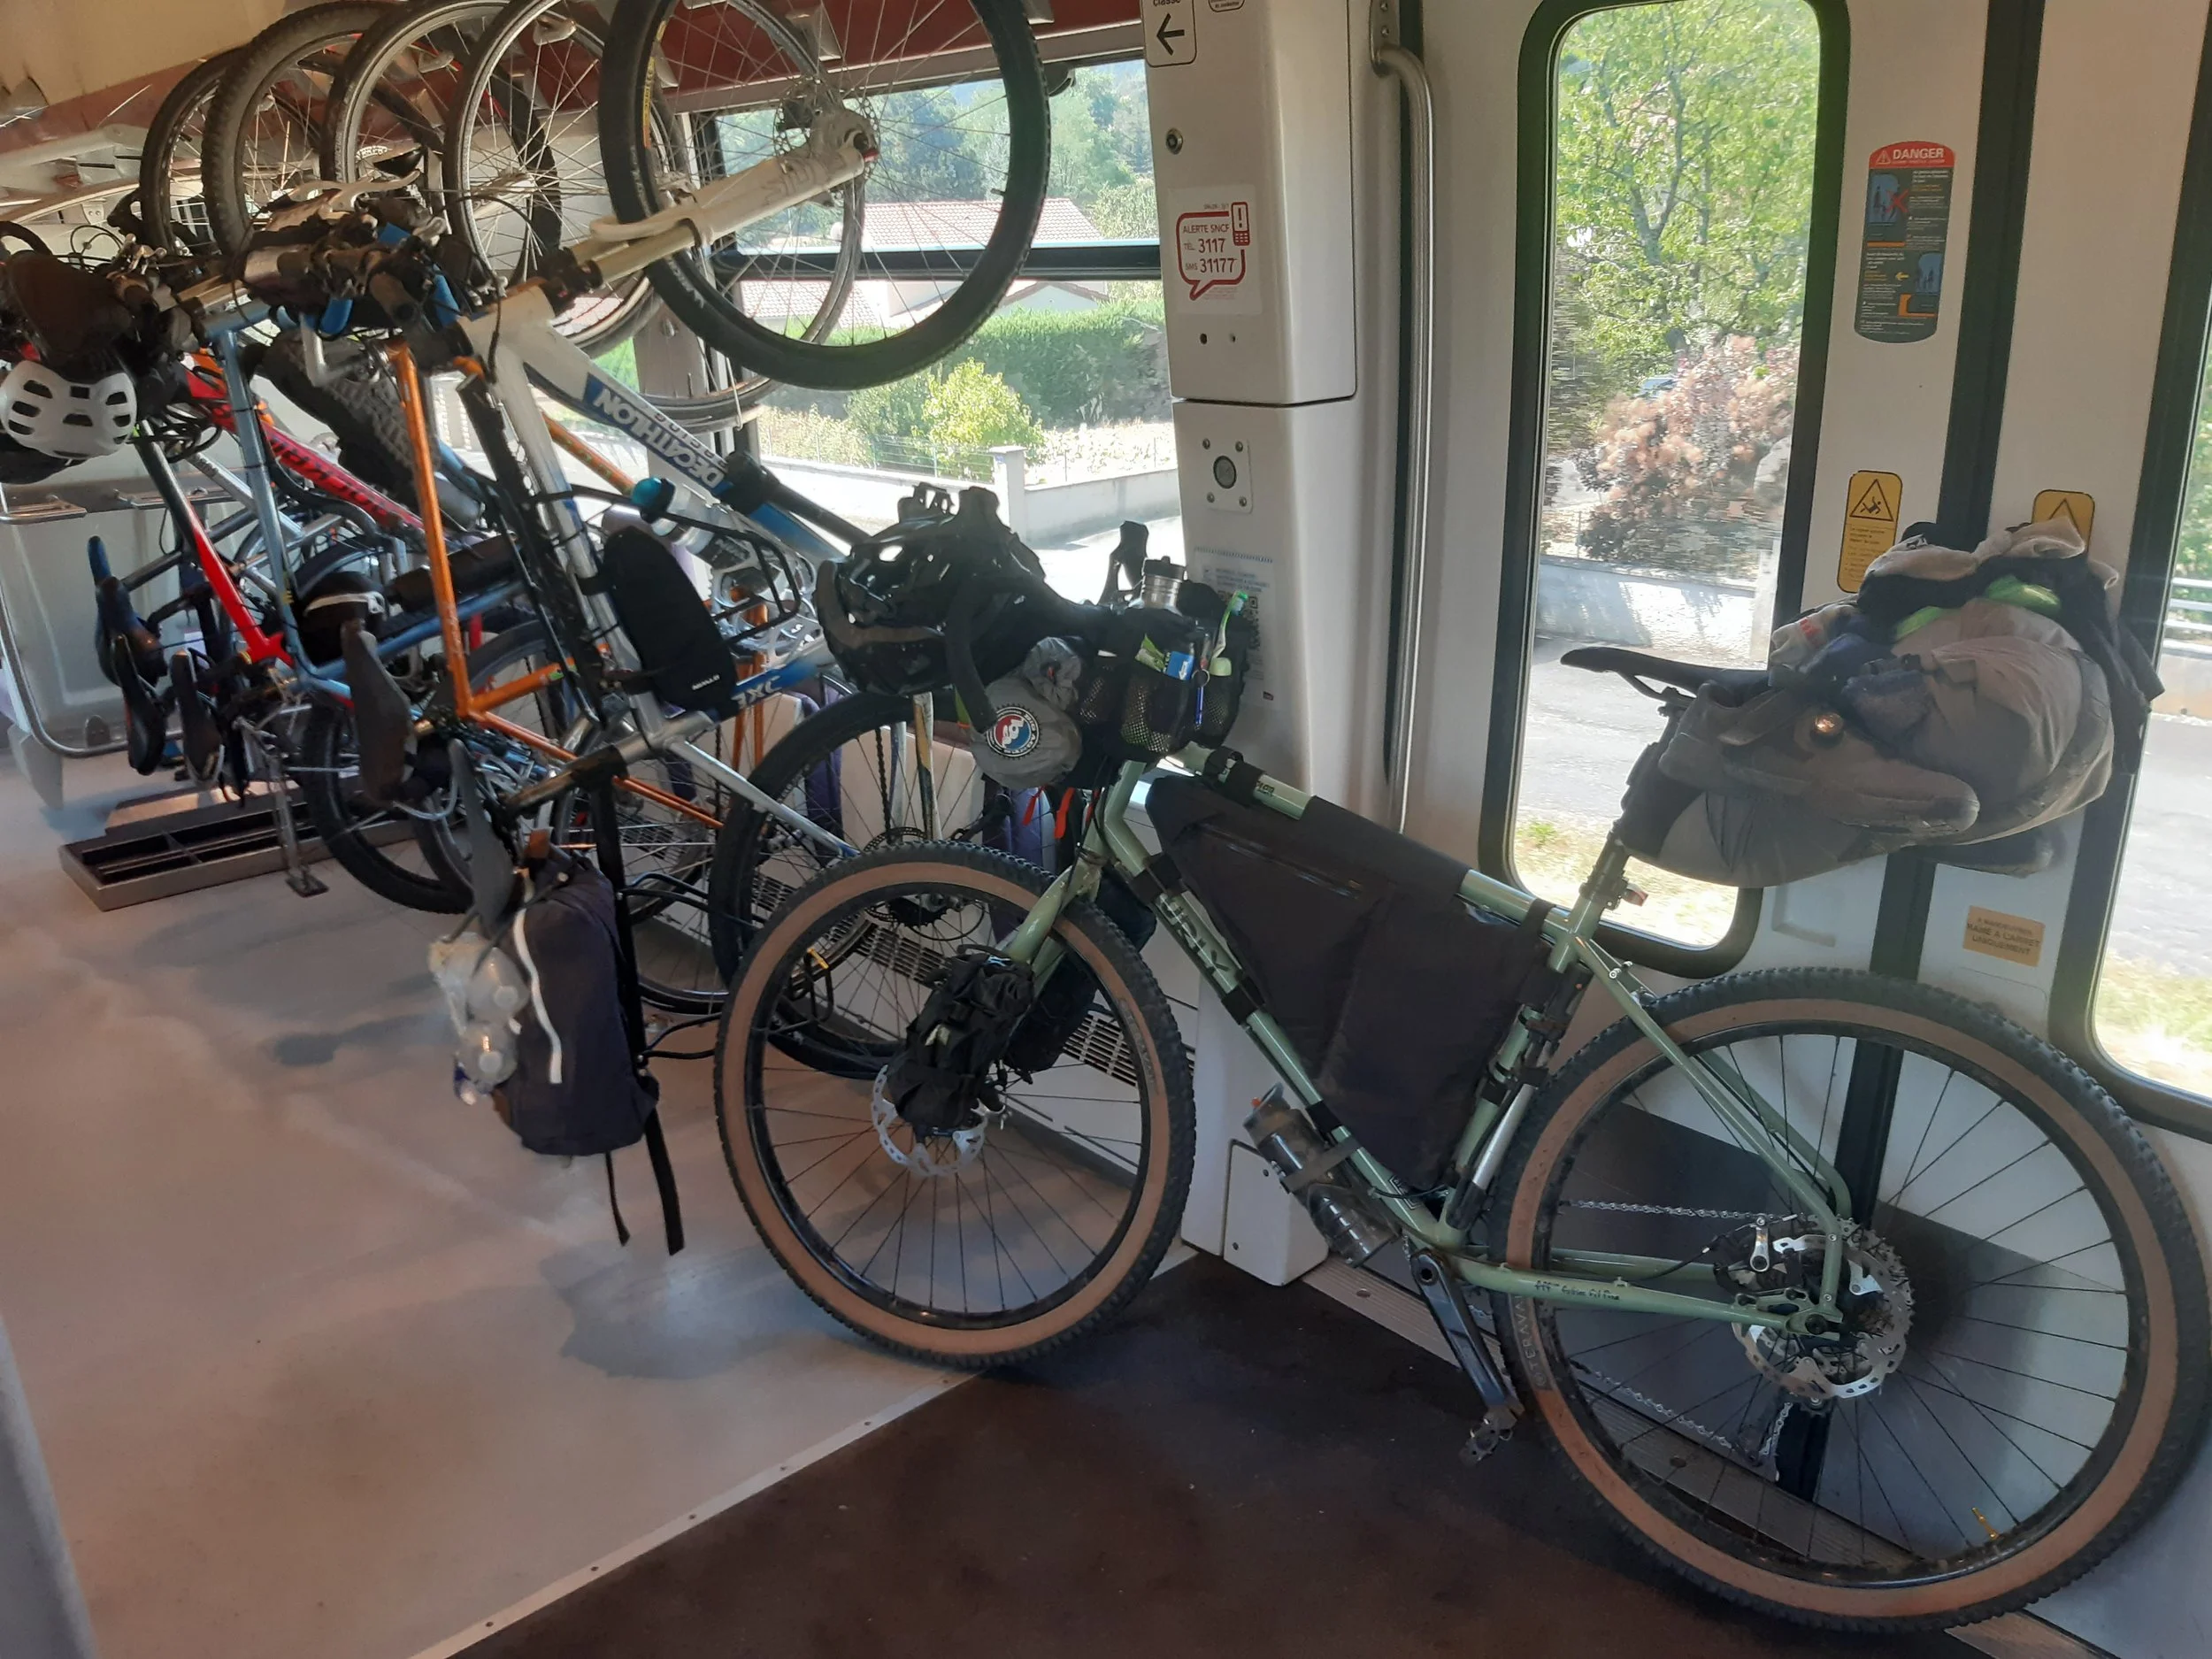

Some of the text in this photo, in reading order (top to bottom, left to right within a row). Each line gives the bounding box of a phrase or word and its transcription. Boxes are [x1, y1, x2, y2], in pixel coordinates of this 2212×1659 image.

[1892, 147, 1945, 160] DANGER
[1182, 223, 1230, 234] ALERTE SNCF
[1198, 238, 1225, 253] 3117
[1200, 257, 1237, 273] 31177
[593, 388, 725, 488] DECATHLON
[1158, 894, 1230, 976] URLY
[1514, 1295, 1538, 1371] TERAVAI
